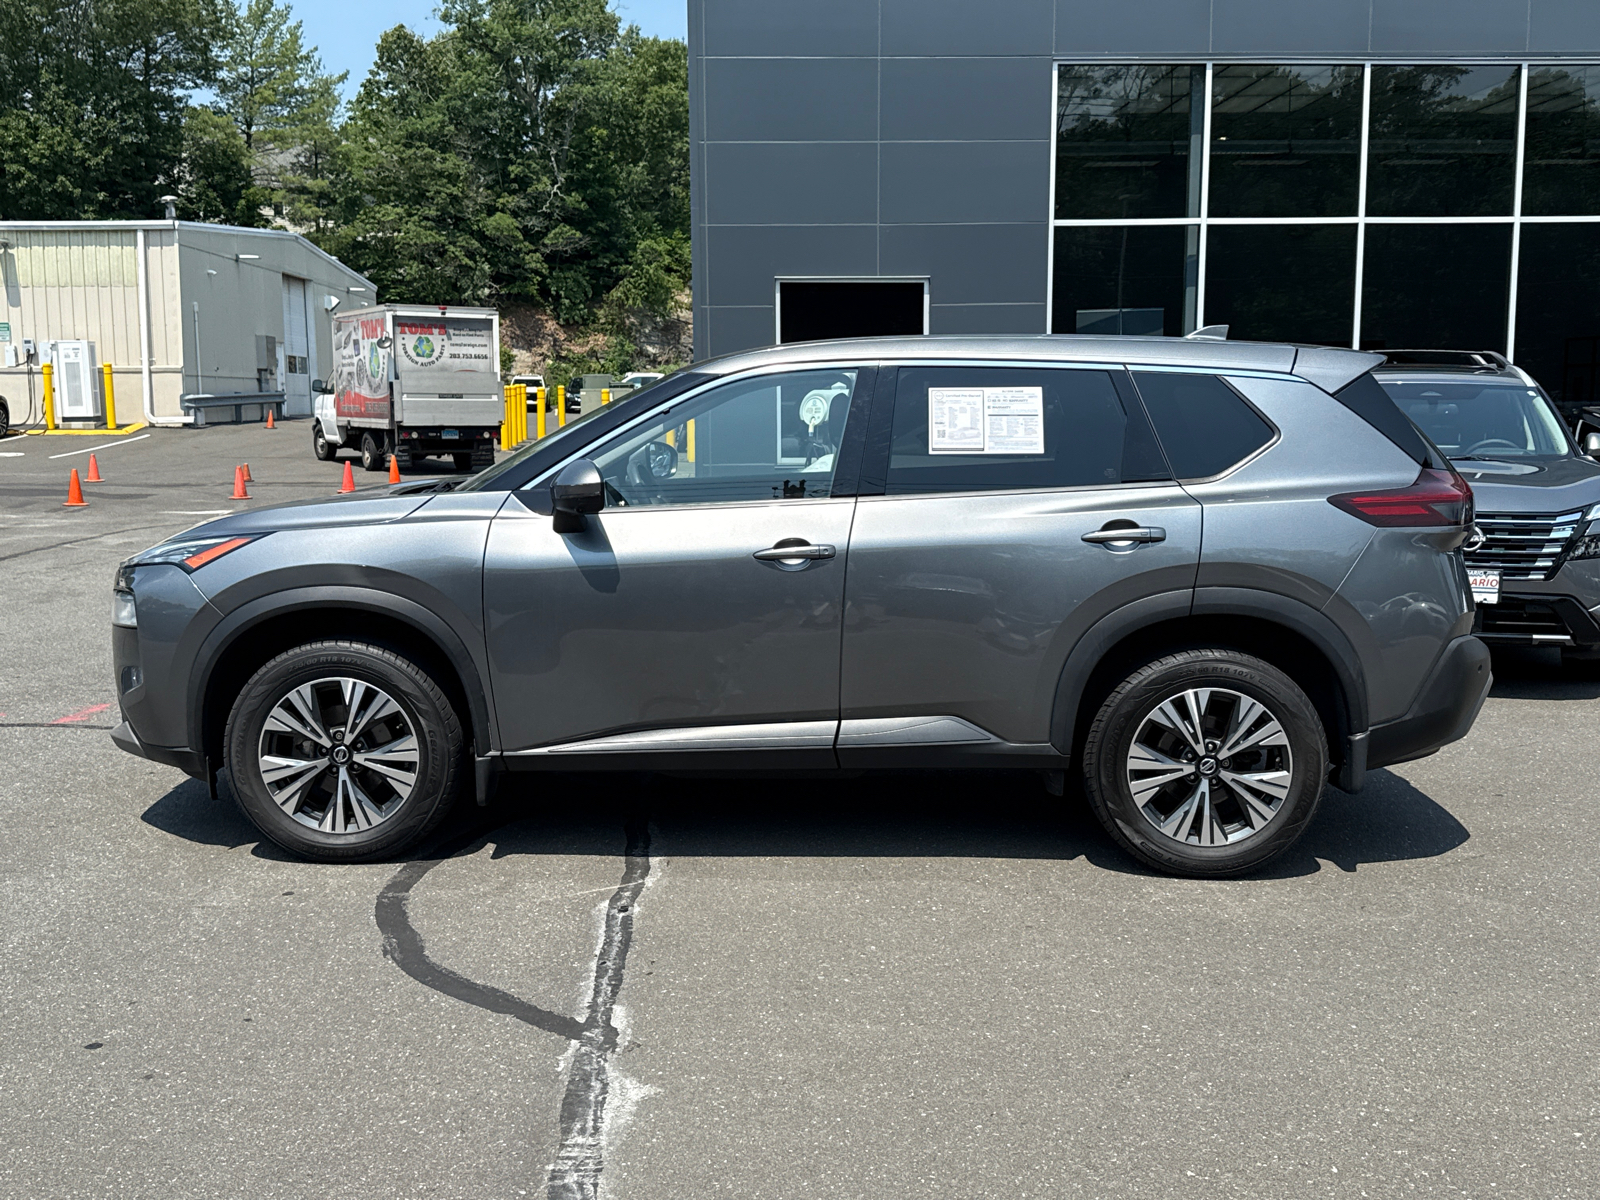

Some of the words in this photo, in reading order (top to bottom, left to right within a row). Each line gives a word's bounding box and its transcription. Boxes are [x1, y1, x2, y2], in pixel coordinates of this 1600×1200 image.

[397, 322, 447, 335] TOM'S
[401, 343, 419, 365] FOREIGN
[435, 344, 446, 362] PARTS
[1471, 578, 1499, 587] ARIO
[341, 656, 364, 665] 107V
[1212, 666, 1230, 674] R18
[1233, 668, 1256, 680] 107V
